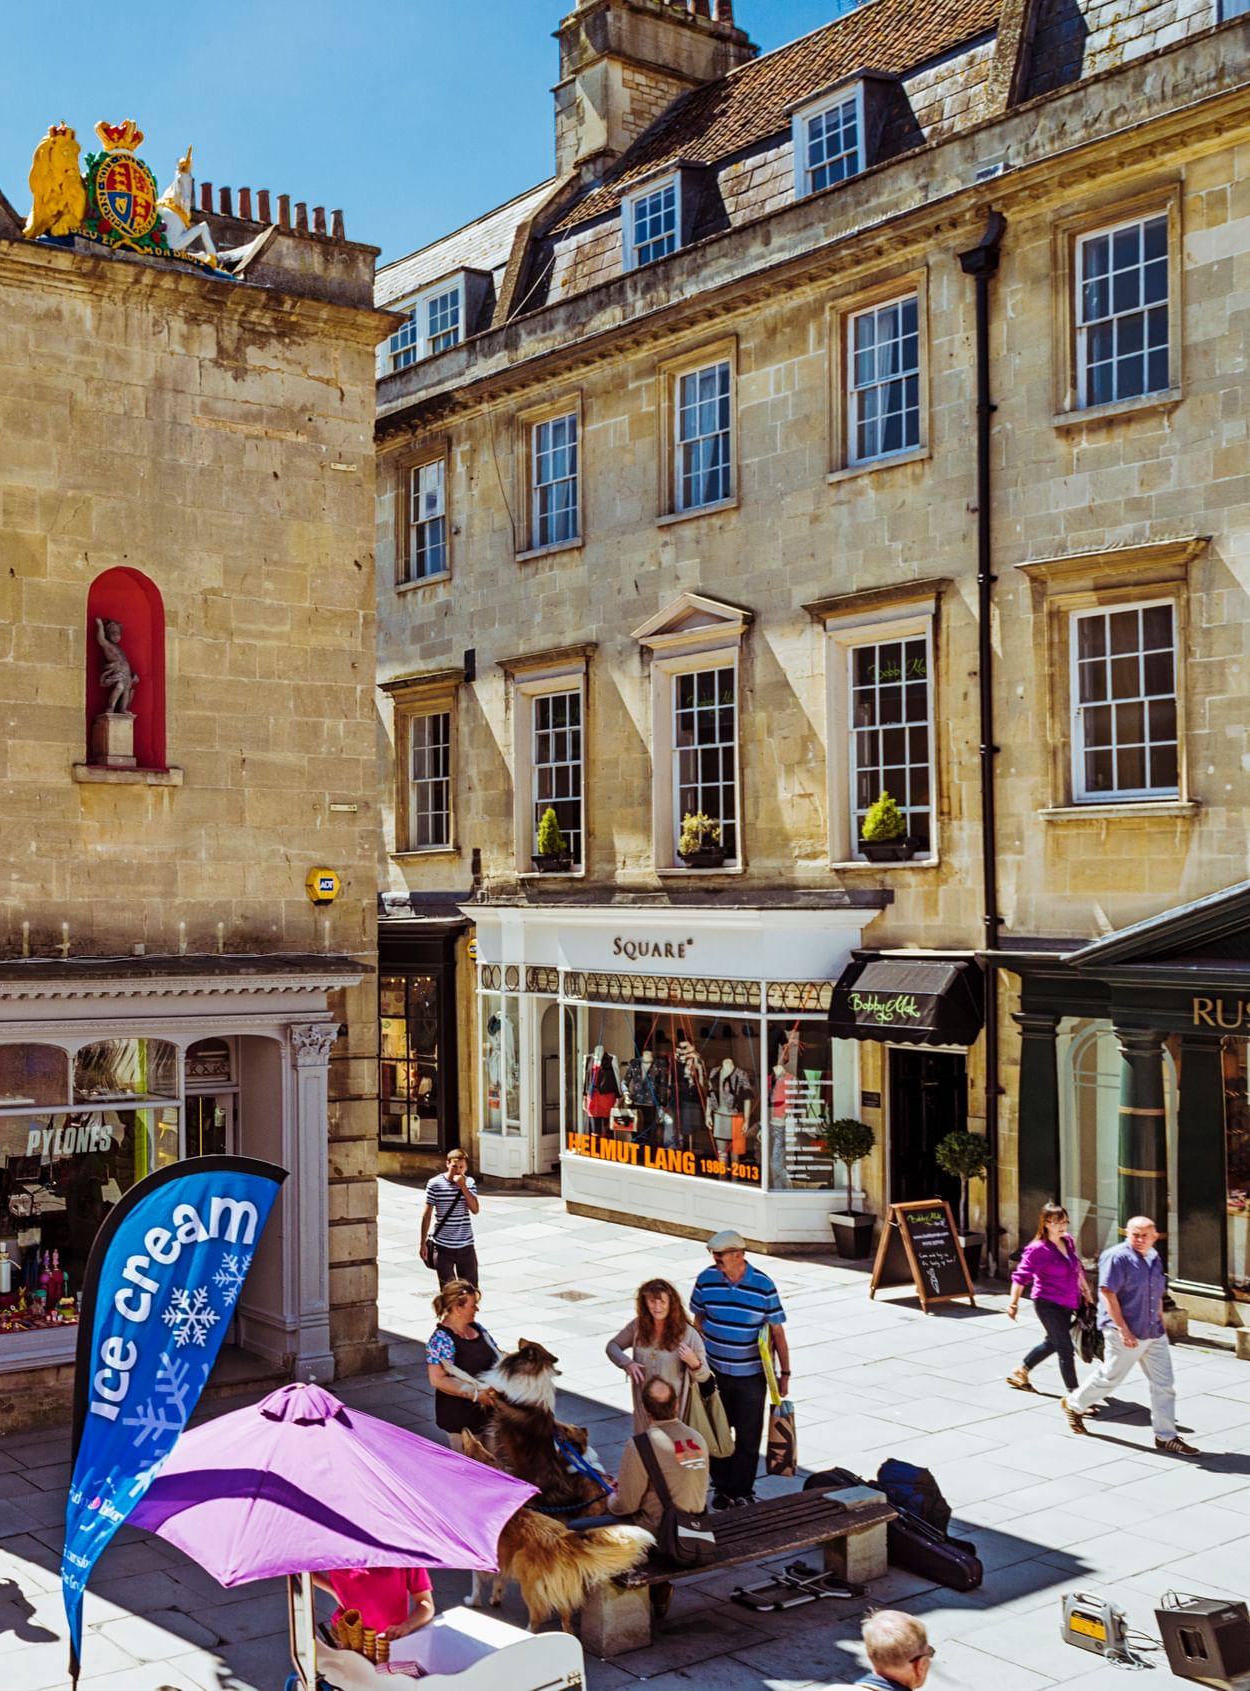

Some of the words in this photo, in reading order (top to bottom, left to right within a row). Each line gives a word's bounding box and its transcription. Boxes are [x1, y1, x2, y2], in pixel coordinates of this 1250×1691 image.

[144, 246, 171, 257] MON
[320, 880, 334, 889] ADT
[613, 937, 686, 961] SQUARE
[847, 993, 894, 1024] Bobby
[26, 1125, 113, 1157] PYLONES
[568, 1132, 641, 1165] HELMUT
[644, 1145, 696, 1175] LANG
[114, 1196, 259, 1323] cream
